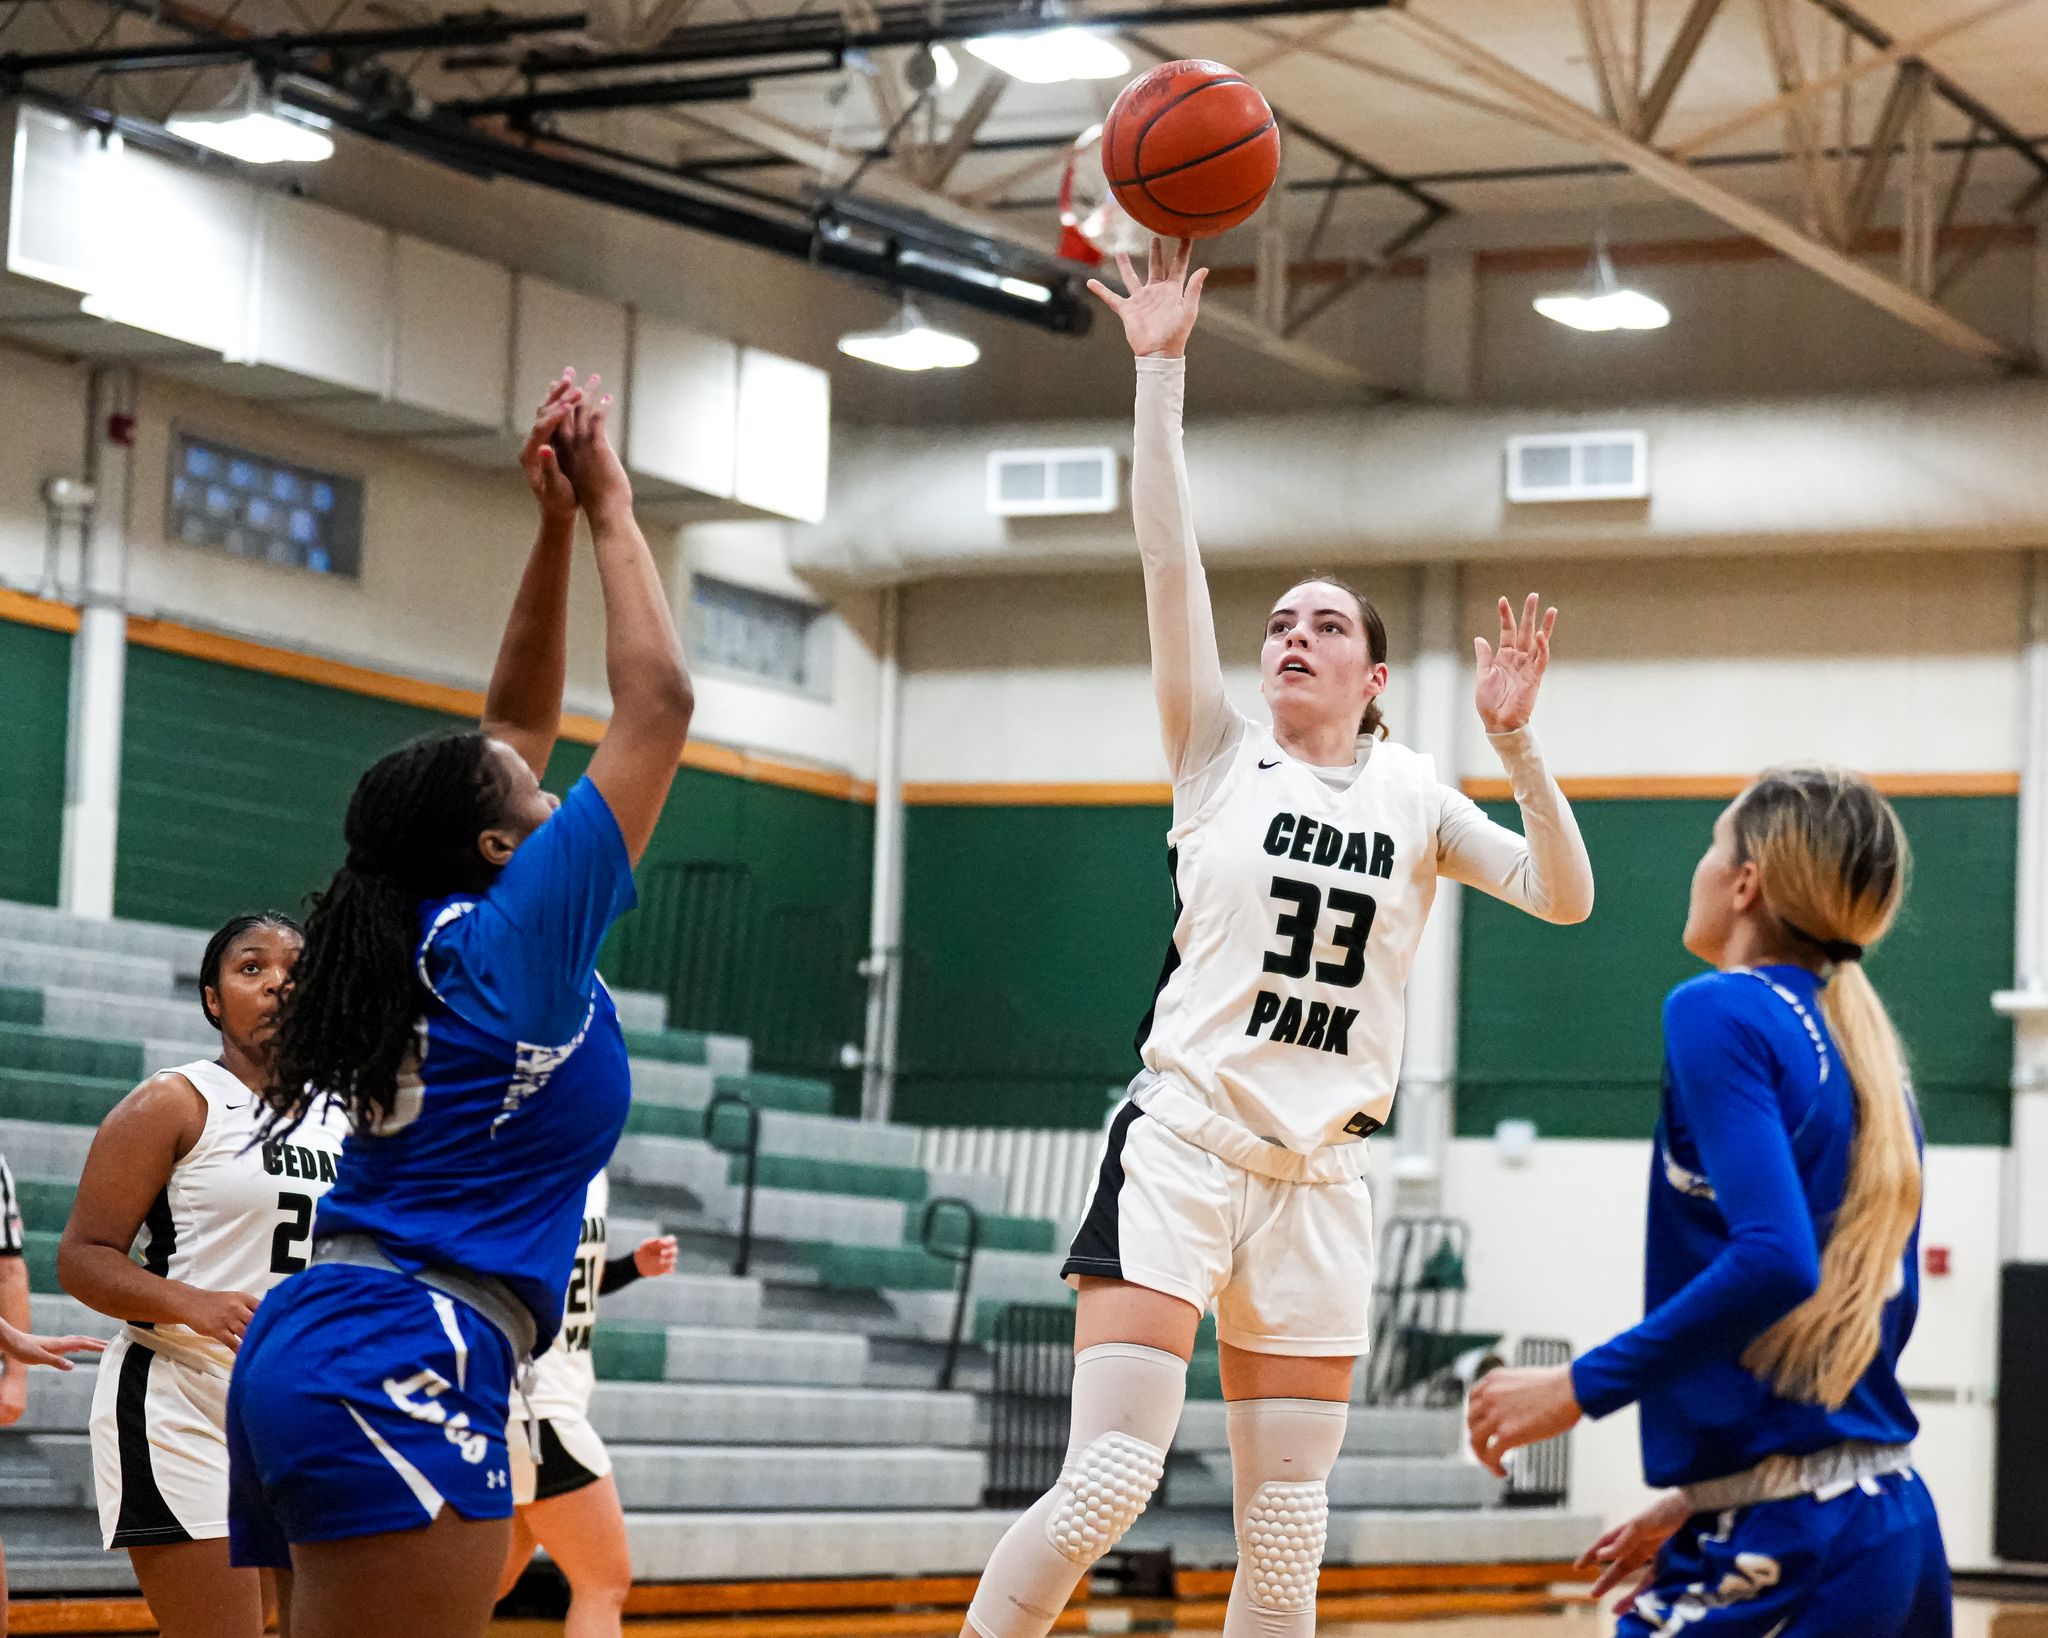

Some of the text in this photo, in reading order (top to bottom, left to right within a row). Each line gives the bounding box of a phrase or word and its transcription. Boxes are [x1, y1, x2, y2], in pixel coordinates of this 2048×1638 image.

[1263, 812, 1395, 879] CEDAR
[1262, 876, 1376, 988] 33
[1245, 990, 1360, 1056] PARK
